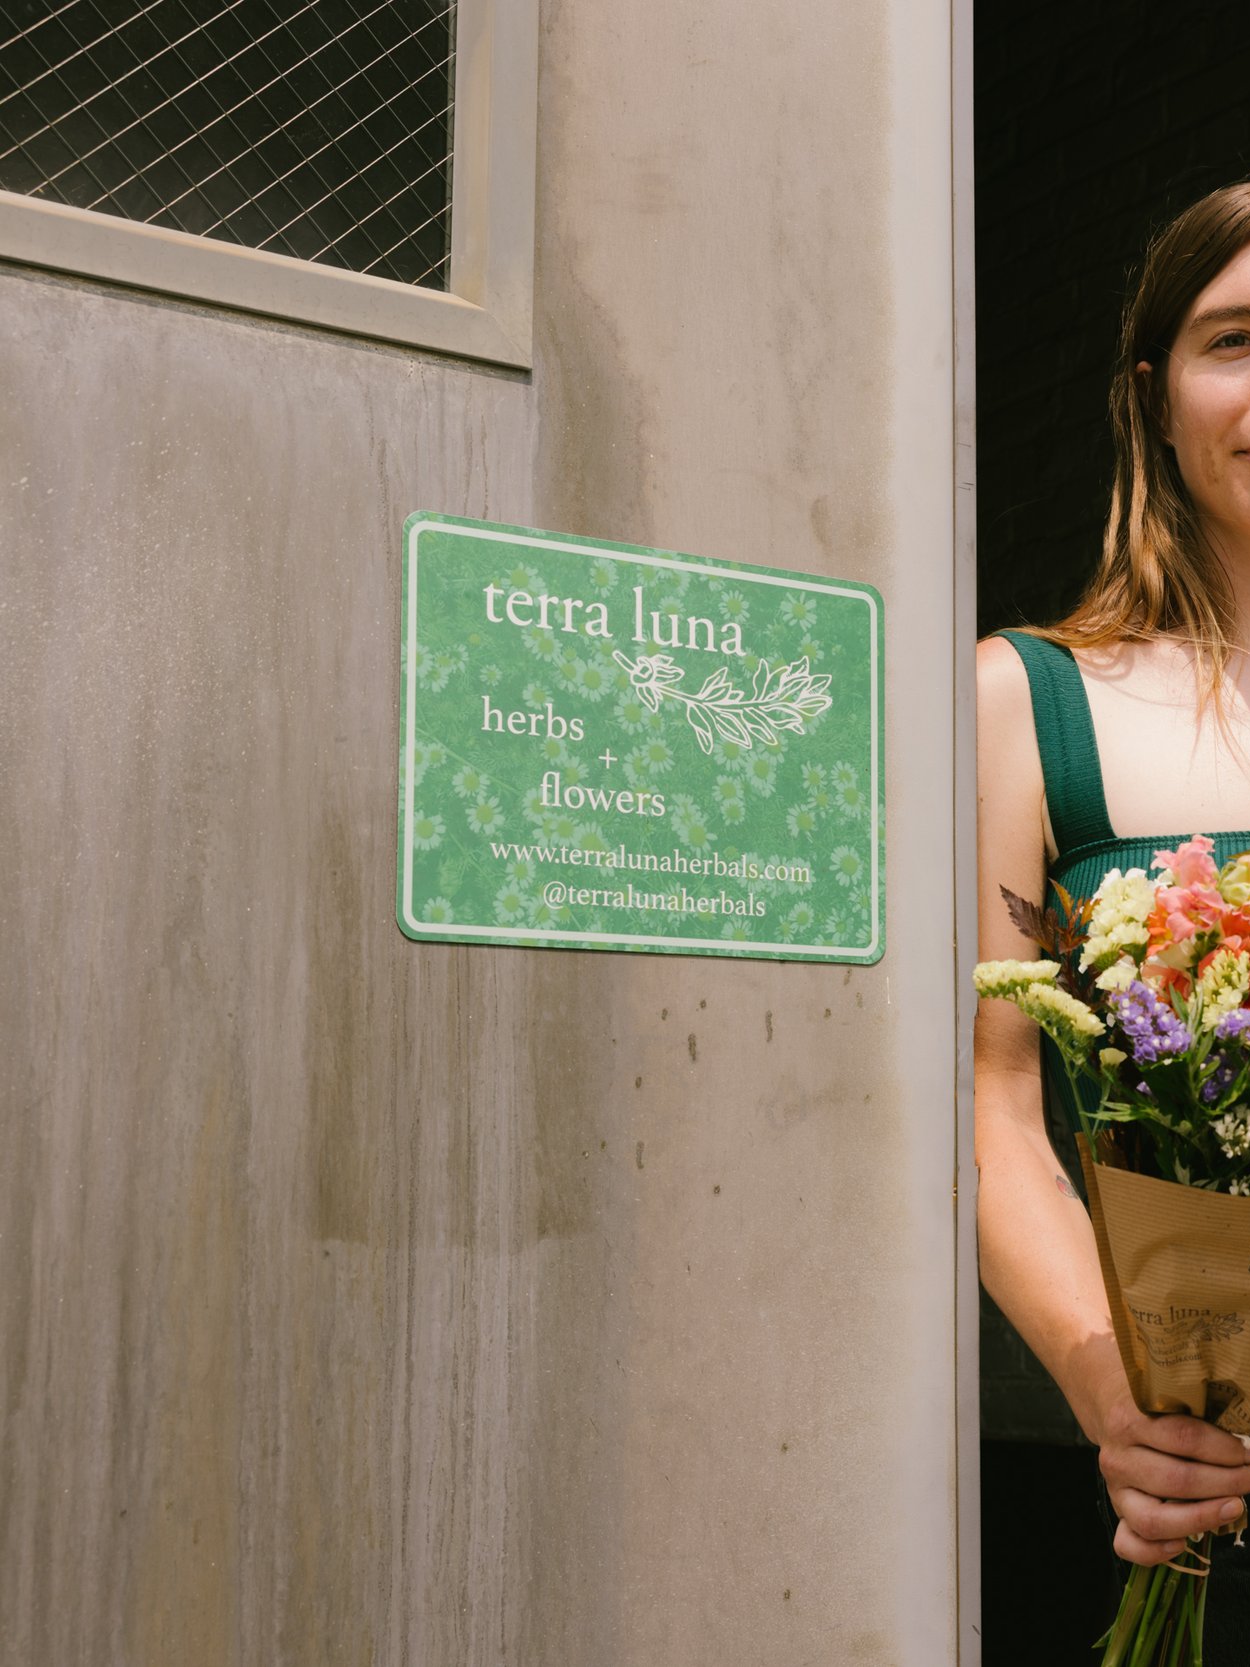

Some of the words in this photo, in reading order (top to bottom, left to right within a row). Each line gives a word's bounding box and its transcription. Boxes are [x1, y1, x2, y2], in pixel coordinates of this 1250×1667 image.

[483, 582, 613, 638] terra
[631, 586, 746, 656] luna
[481, 695, 585, 741] herbs
[598, 748, 618, 769] +
[539, 771, 666, 817] flowers
[490, 841, 811, 883] www.terralunaherbals.com
[543, 881, 766, 917] @terralunaherbals
[1169, 1306, 1211, 1323] luna
[1207, 1380, 1238, 1397] erra
